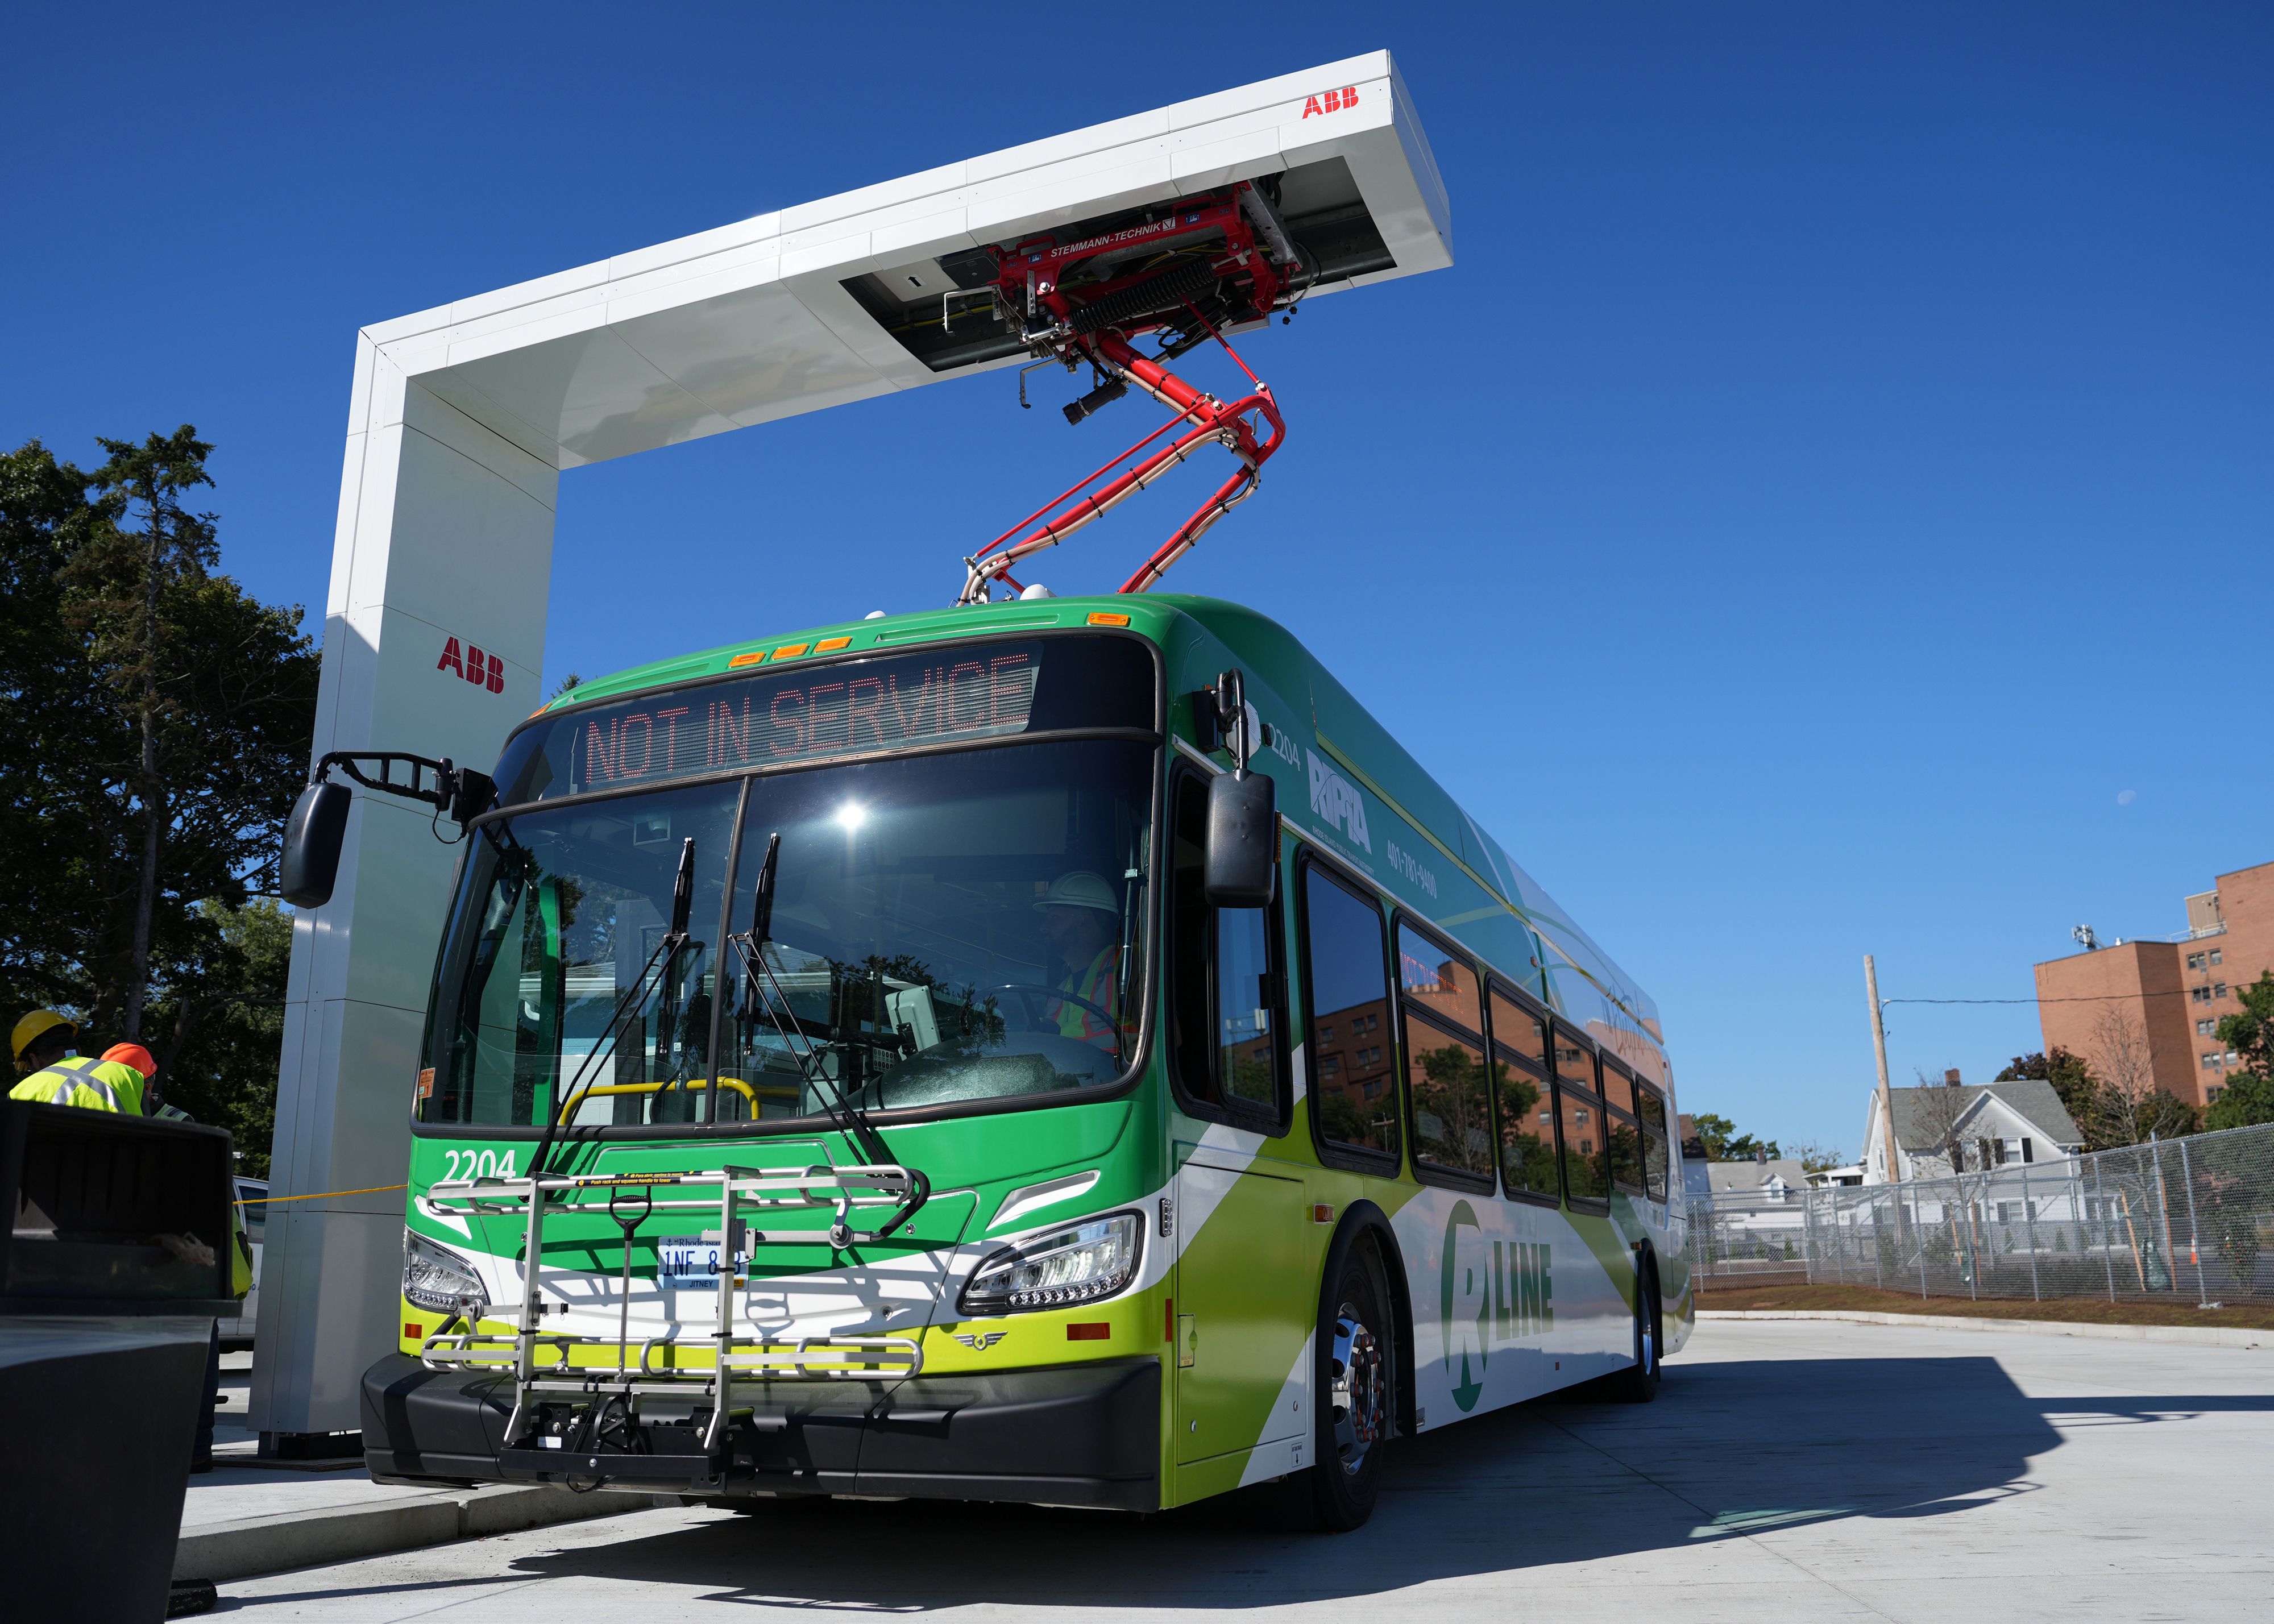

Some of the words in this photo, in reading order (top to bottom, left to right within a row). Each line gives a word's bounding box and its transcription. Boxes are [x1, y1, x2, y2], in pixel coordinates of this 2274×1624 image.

[1302, 86, 1359, 119] ABB
[1051, 222, 1161, 257] STEMMANN-TECHNIK
[437, 636, 504, 694] ABB
[585, 706, 689, 783] NOT
[707, 696, 750, 766] IN
[769, 653, 1028, 757] SERVICE
[1268, 722, 1301, 772] 2204
[1388, 839, 1437, 899] 401-781-9400
[442, 1149, 516, 1181] 2204
[663, 1250, 695, 1276] 1NF
[678, 1238, 704, 1247] Rhode
[1493, 1241, 1554, 1341] LINE
